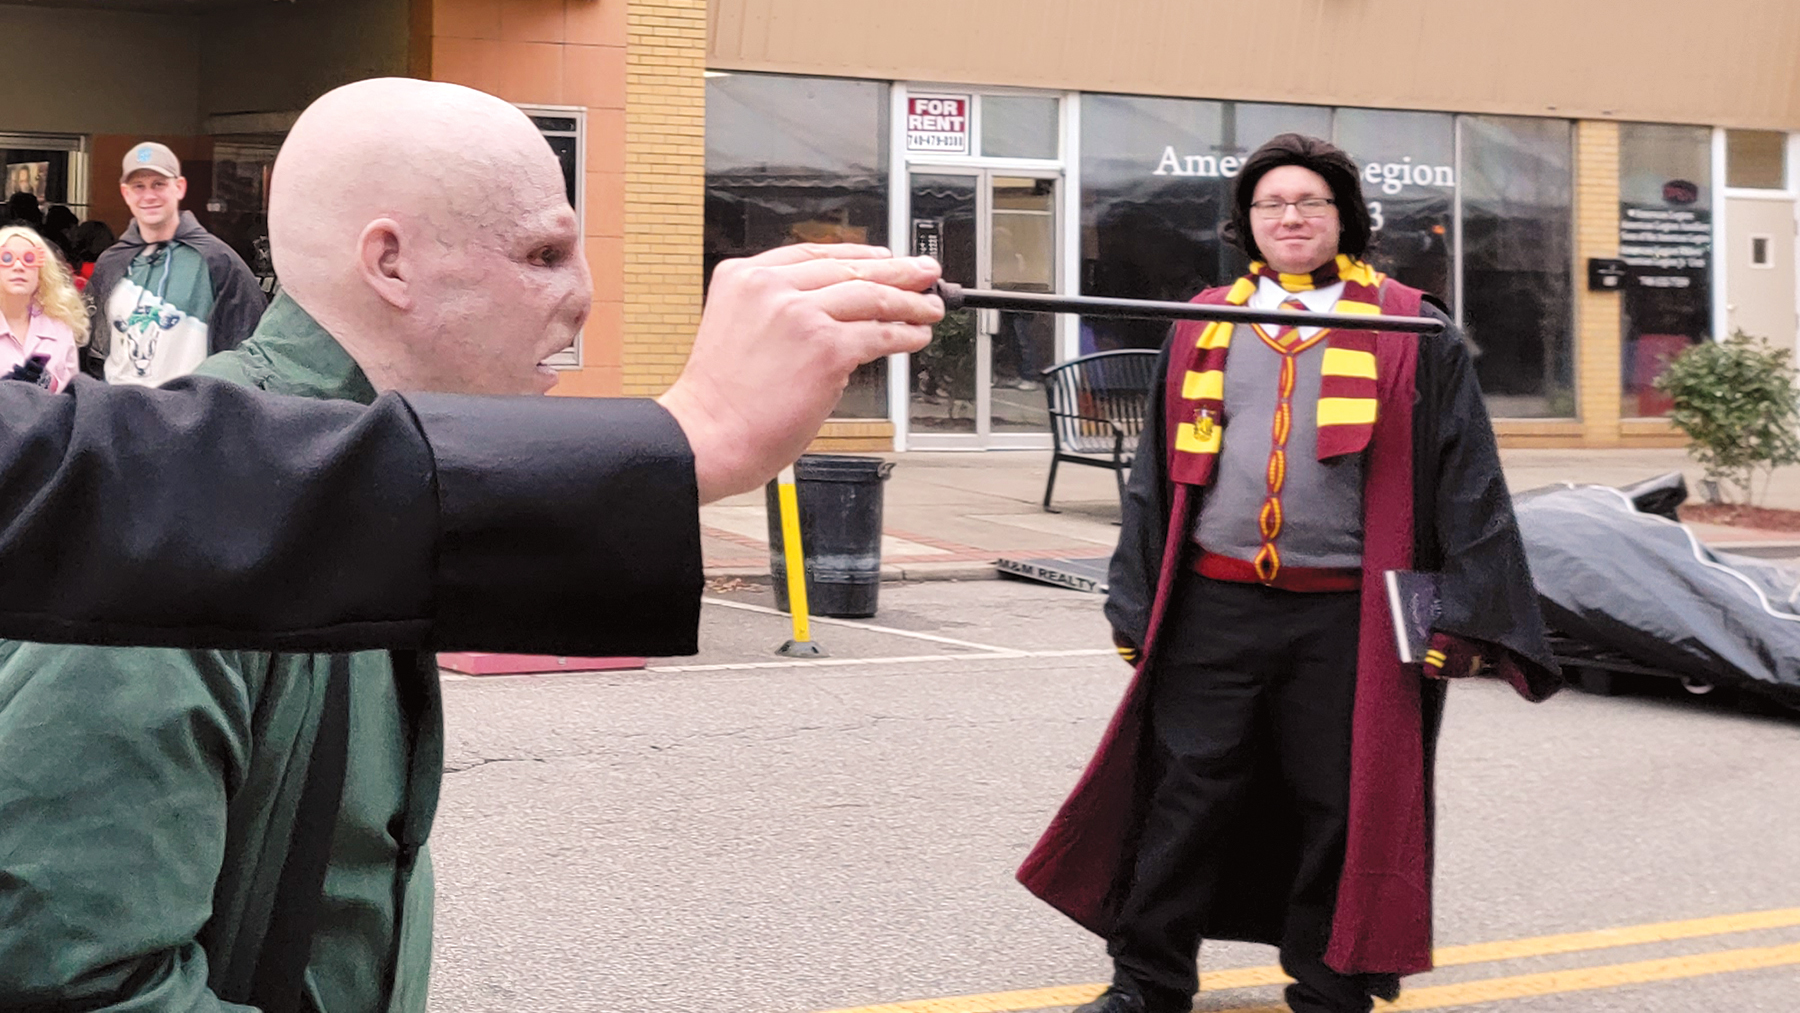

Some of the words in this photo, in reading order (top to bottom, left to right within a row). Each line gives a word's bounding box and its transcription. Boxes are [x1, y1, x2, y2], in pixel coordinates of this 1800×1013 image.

[915, 99, 958, 115] FOR
[908, 115, 964, 131] RENT
[1359, 157, 1457, 194] egion
[1038, 567, 1097, 591] REALTY
